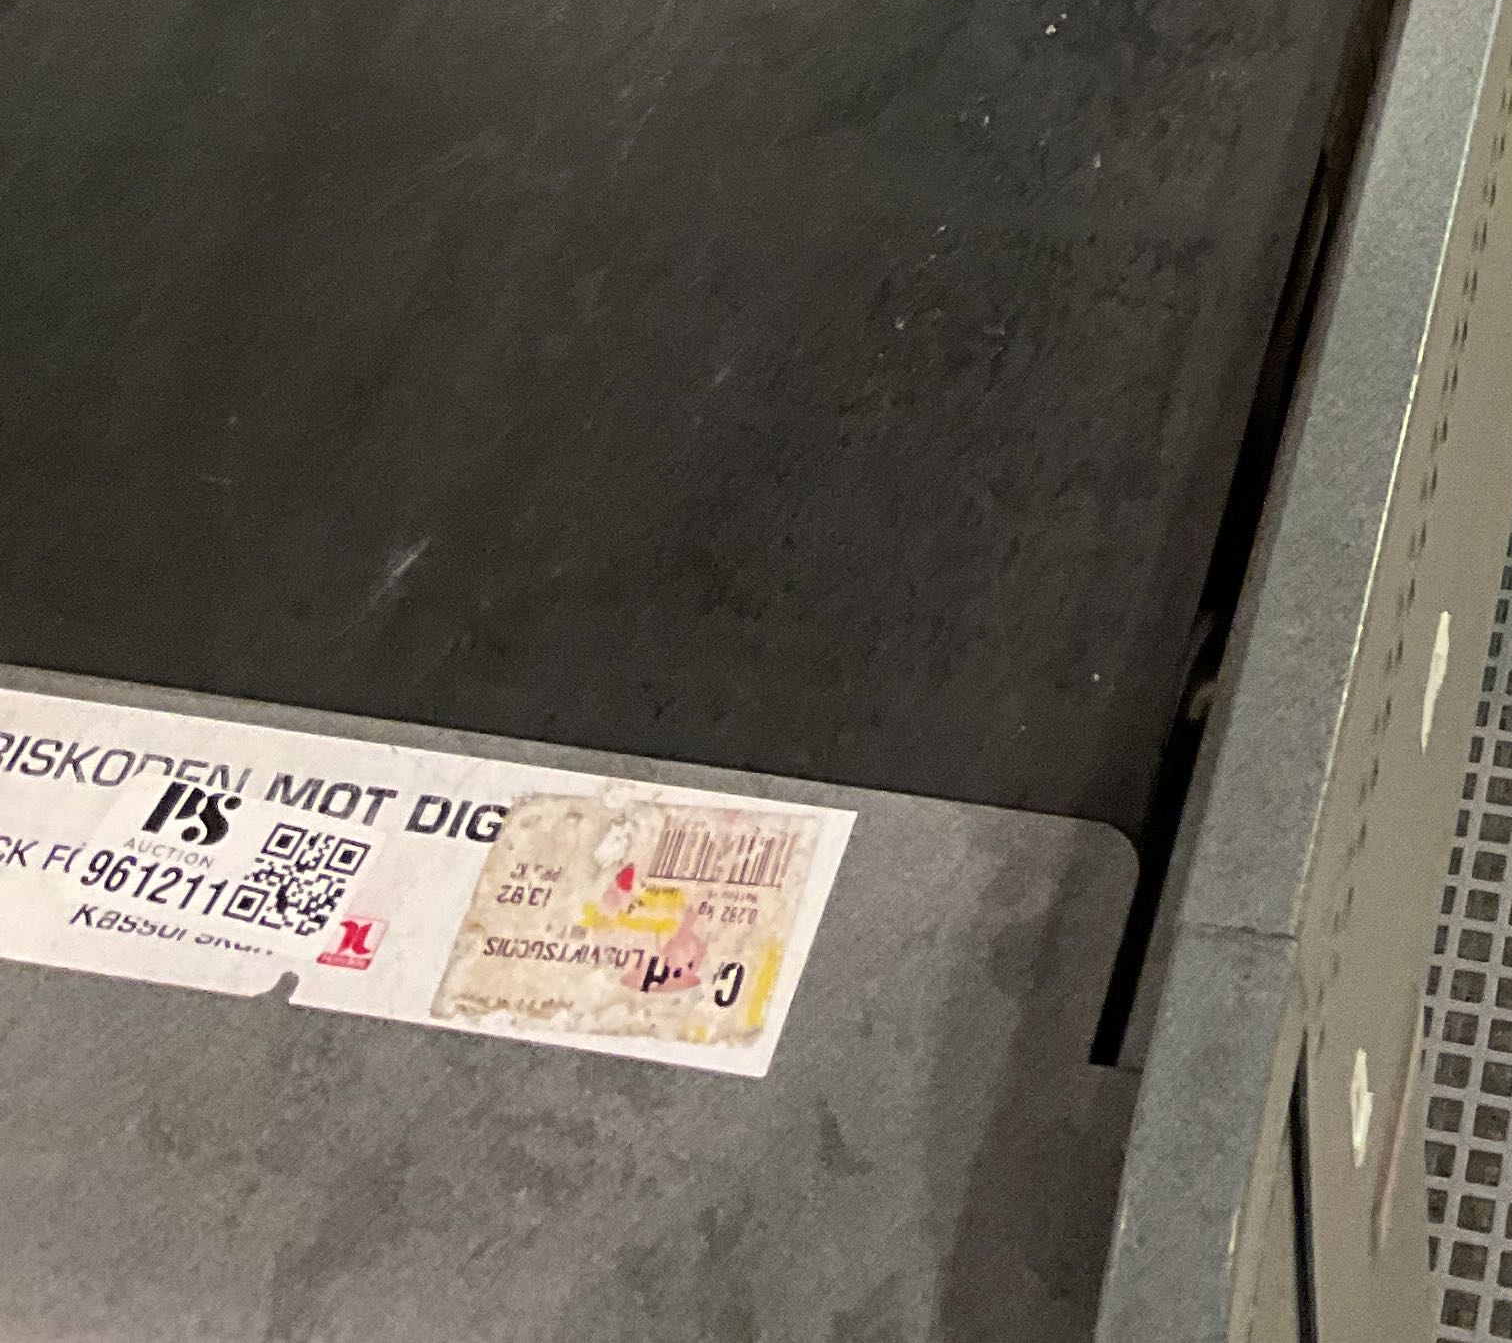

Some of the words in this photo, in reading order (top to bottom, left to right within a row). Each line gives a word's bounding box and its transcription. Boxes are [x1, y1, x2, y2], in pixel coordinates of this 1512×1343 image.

[141, 780, 244, 847] PS
[263, 772, 399, 827] MOT
[404, 793, 513, 844] DIG
[80, 848, 230, 917] 961211
[123, 836, 215, 870] AUCTION
